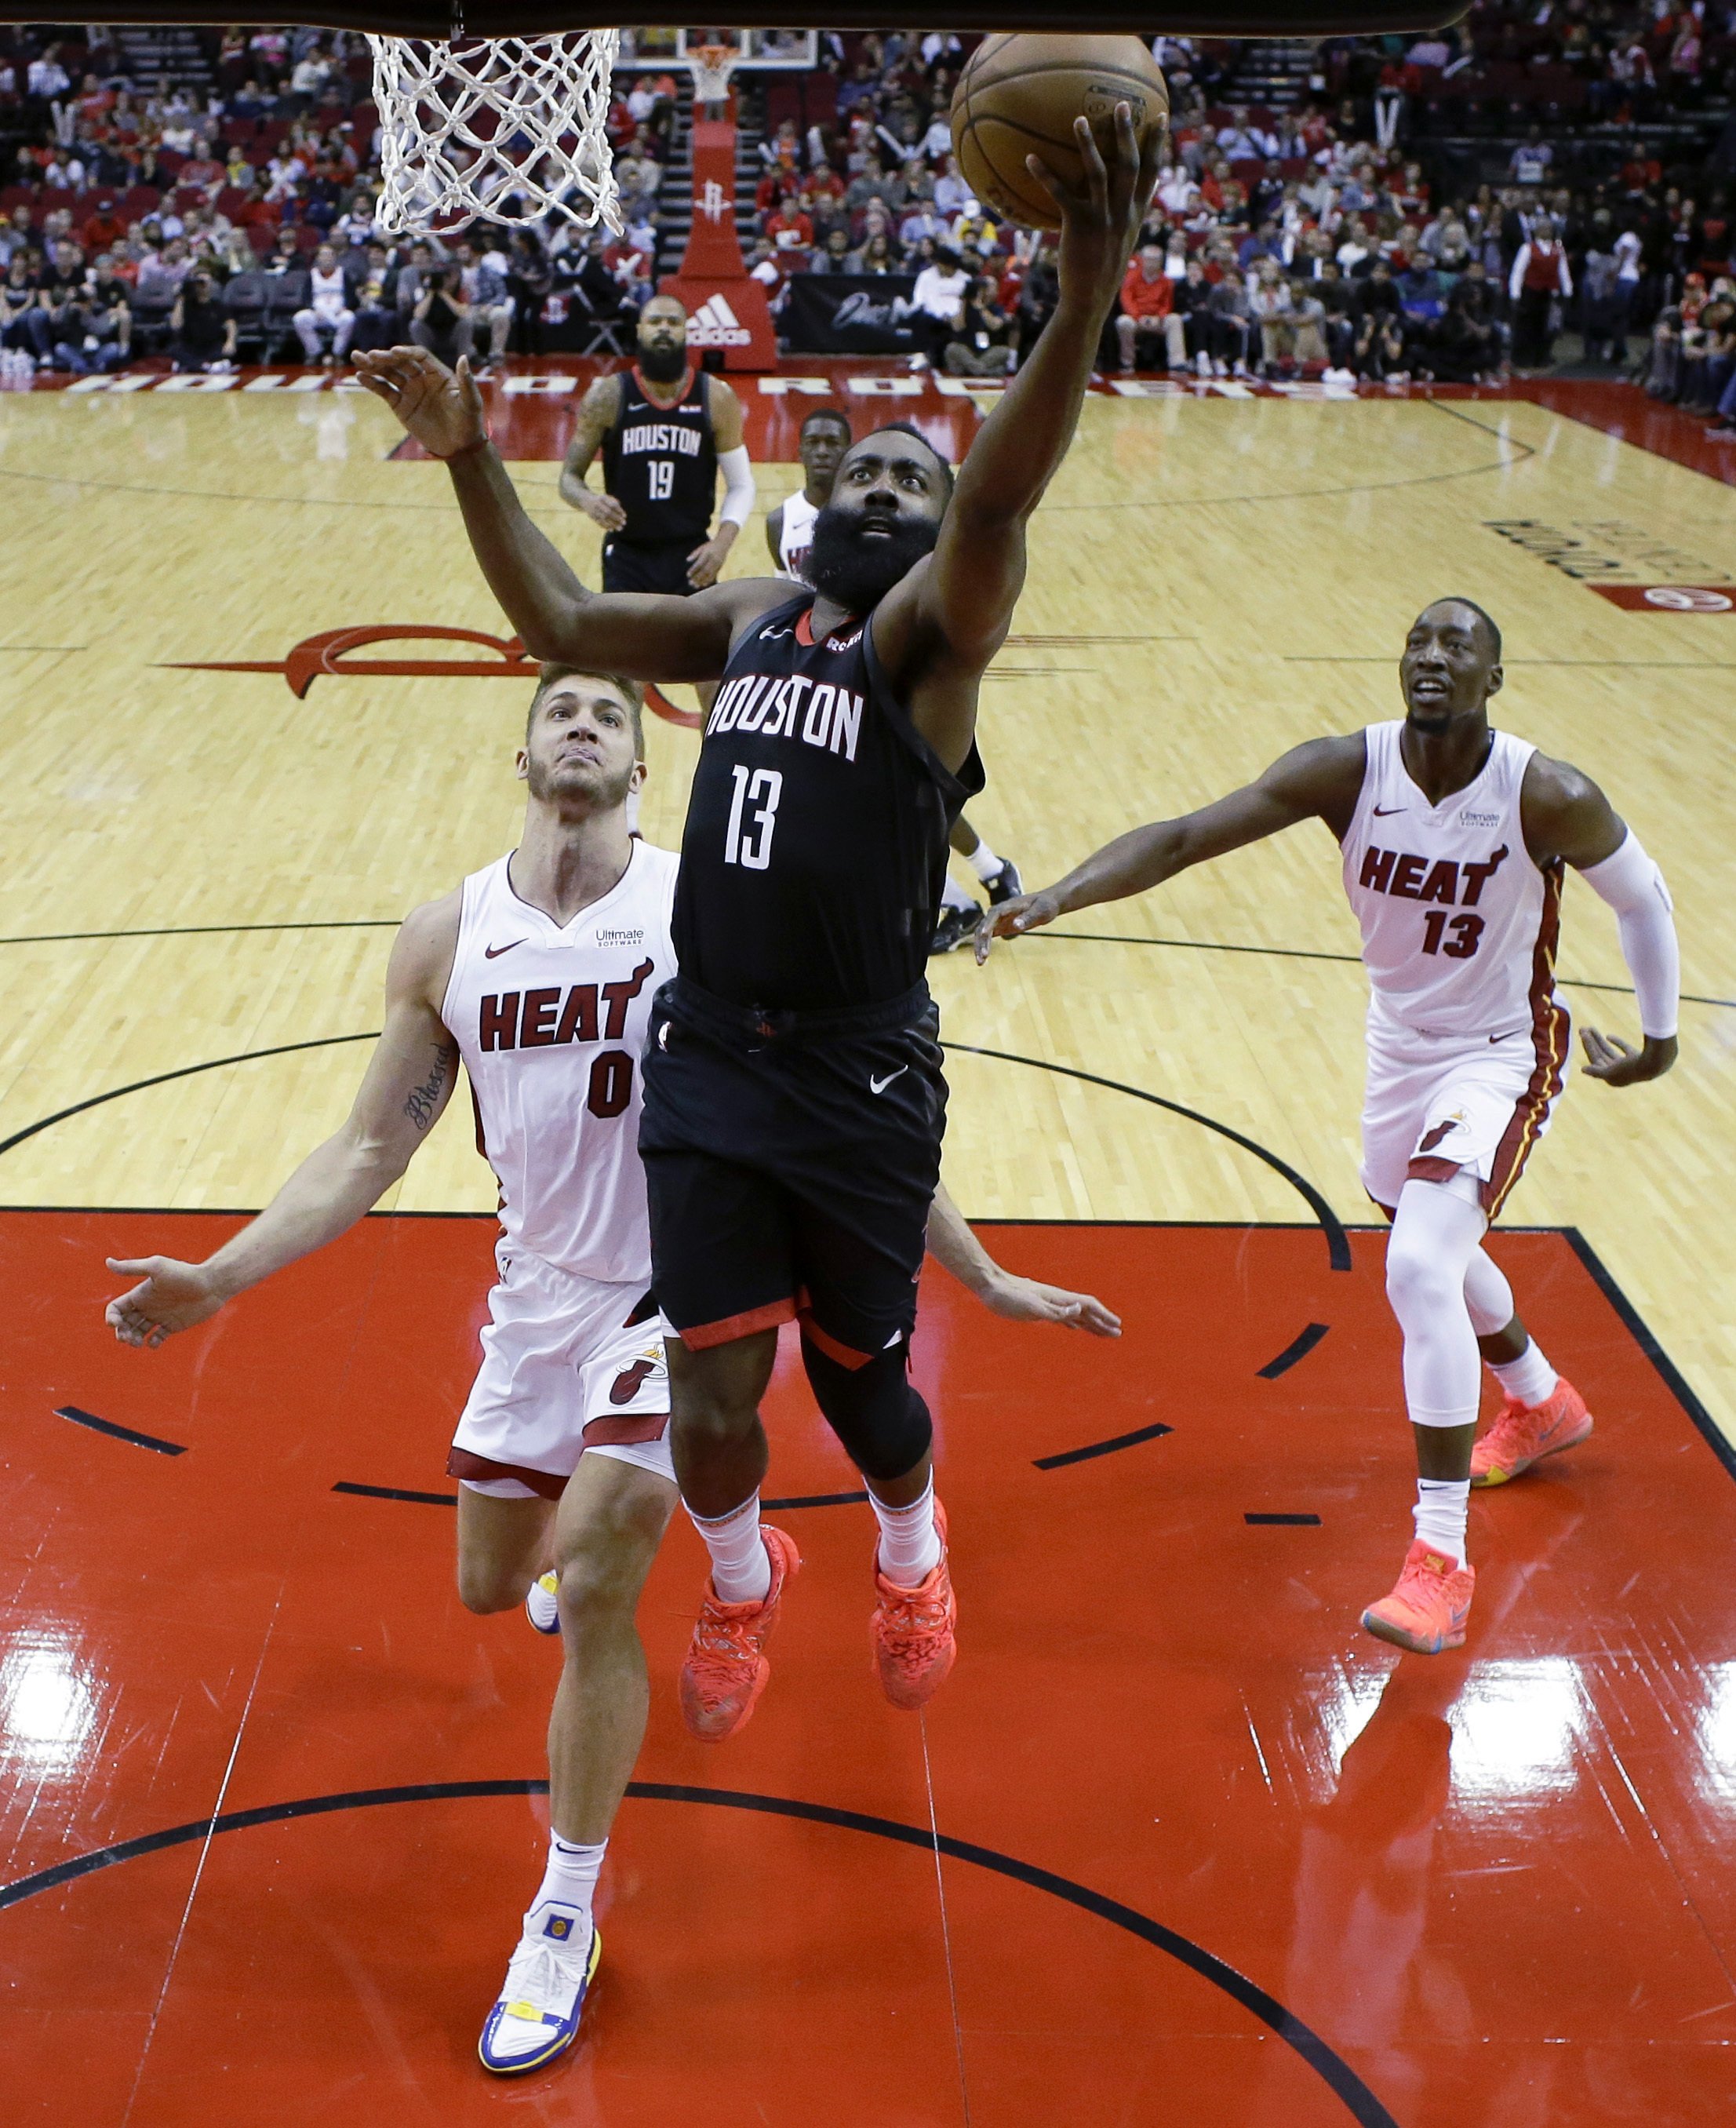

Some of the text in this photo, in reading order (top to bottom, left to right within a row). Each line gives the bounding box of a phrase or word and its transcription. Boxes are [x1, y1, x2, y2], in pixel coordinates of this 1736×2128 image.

[622, 425, 702, 457] HOUSTON
[647, 461, 675, 500] 19
[707, 673, 864, 763] HOUSTON
[724, 763, 784, 870] 13
[1359, 844, 1509, 906] HEAT
[596, 929, 644, 941] Ultimate
[1421, 910, 1486, 958] 13
[479, 957, 654, 1052] HEAT
[588, 1050, 634, 1119] 0
